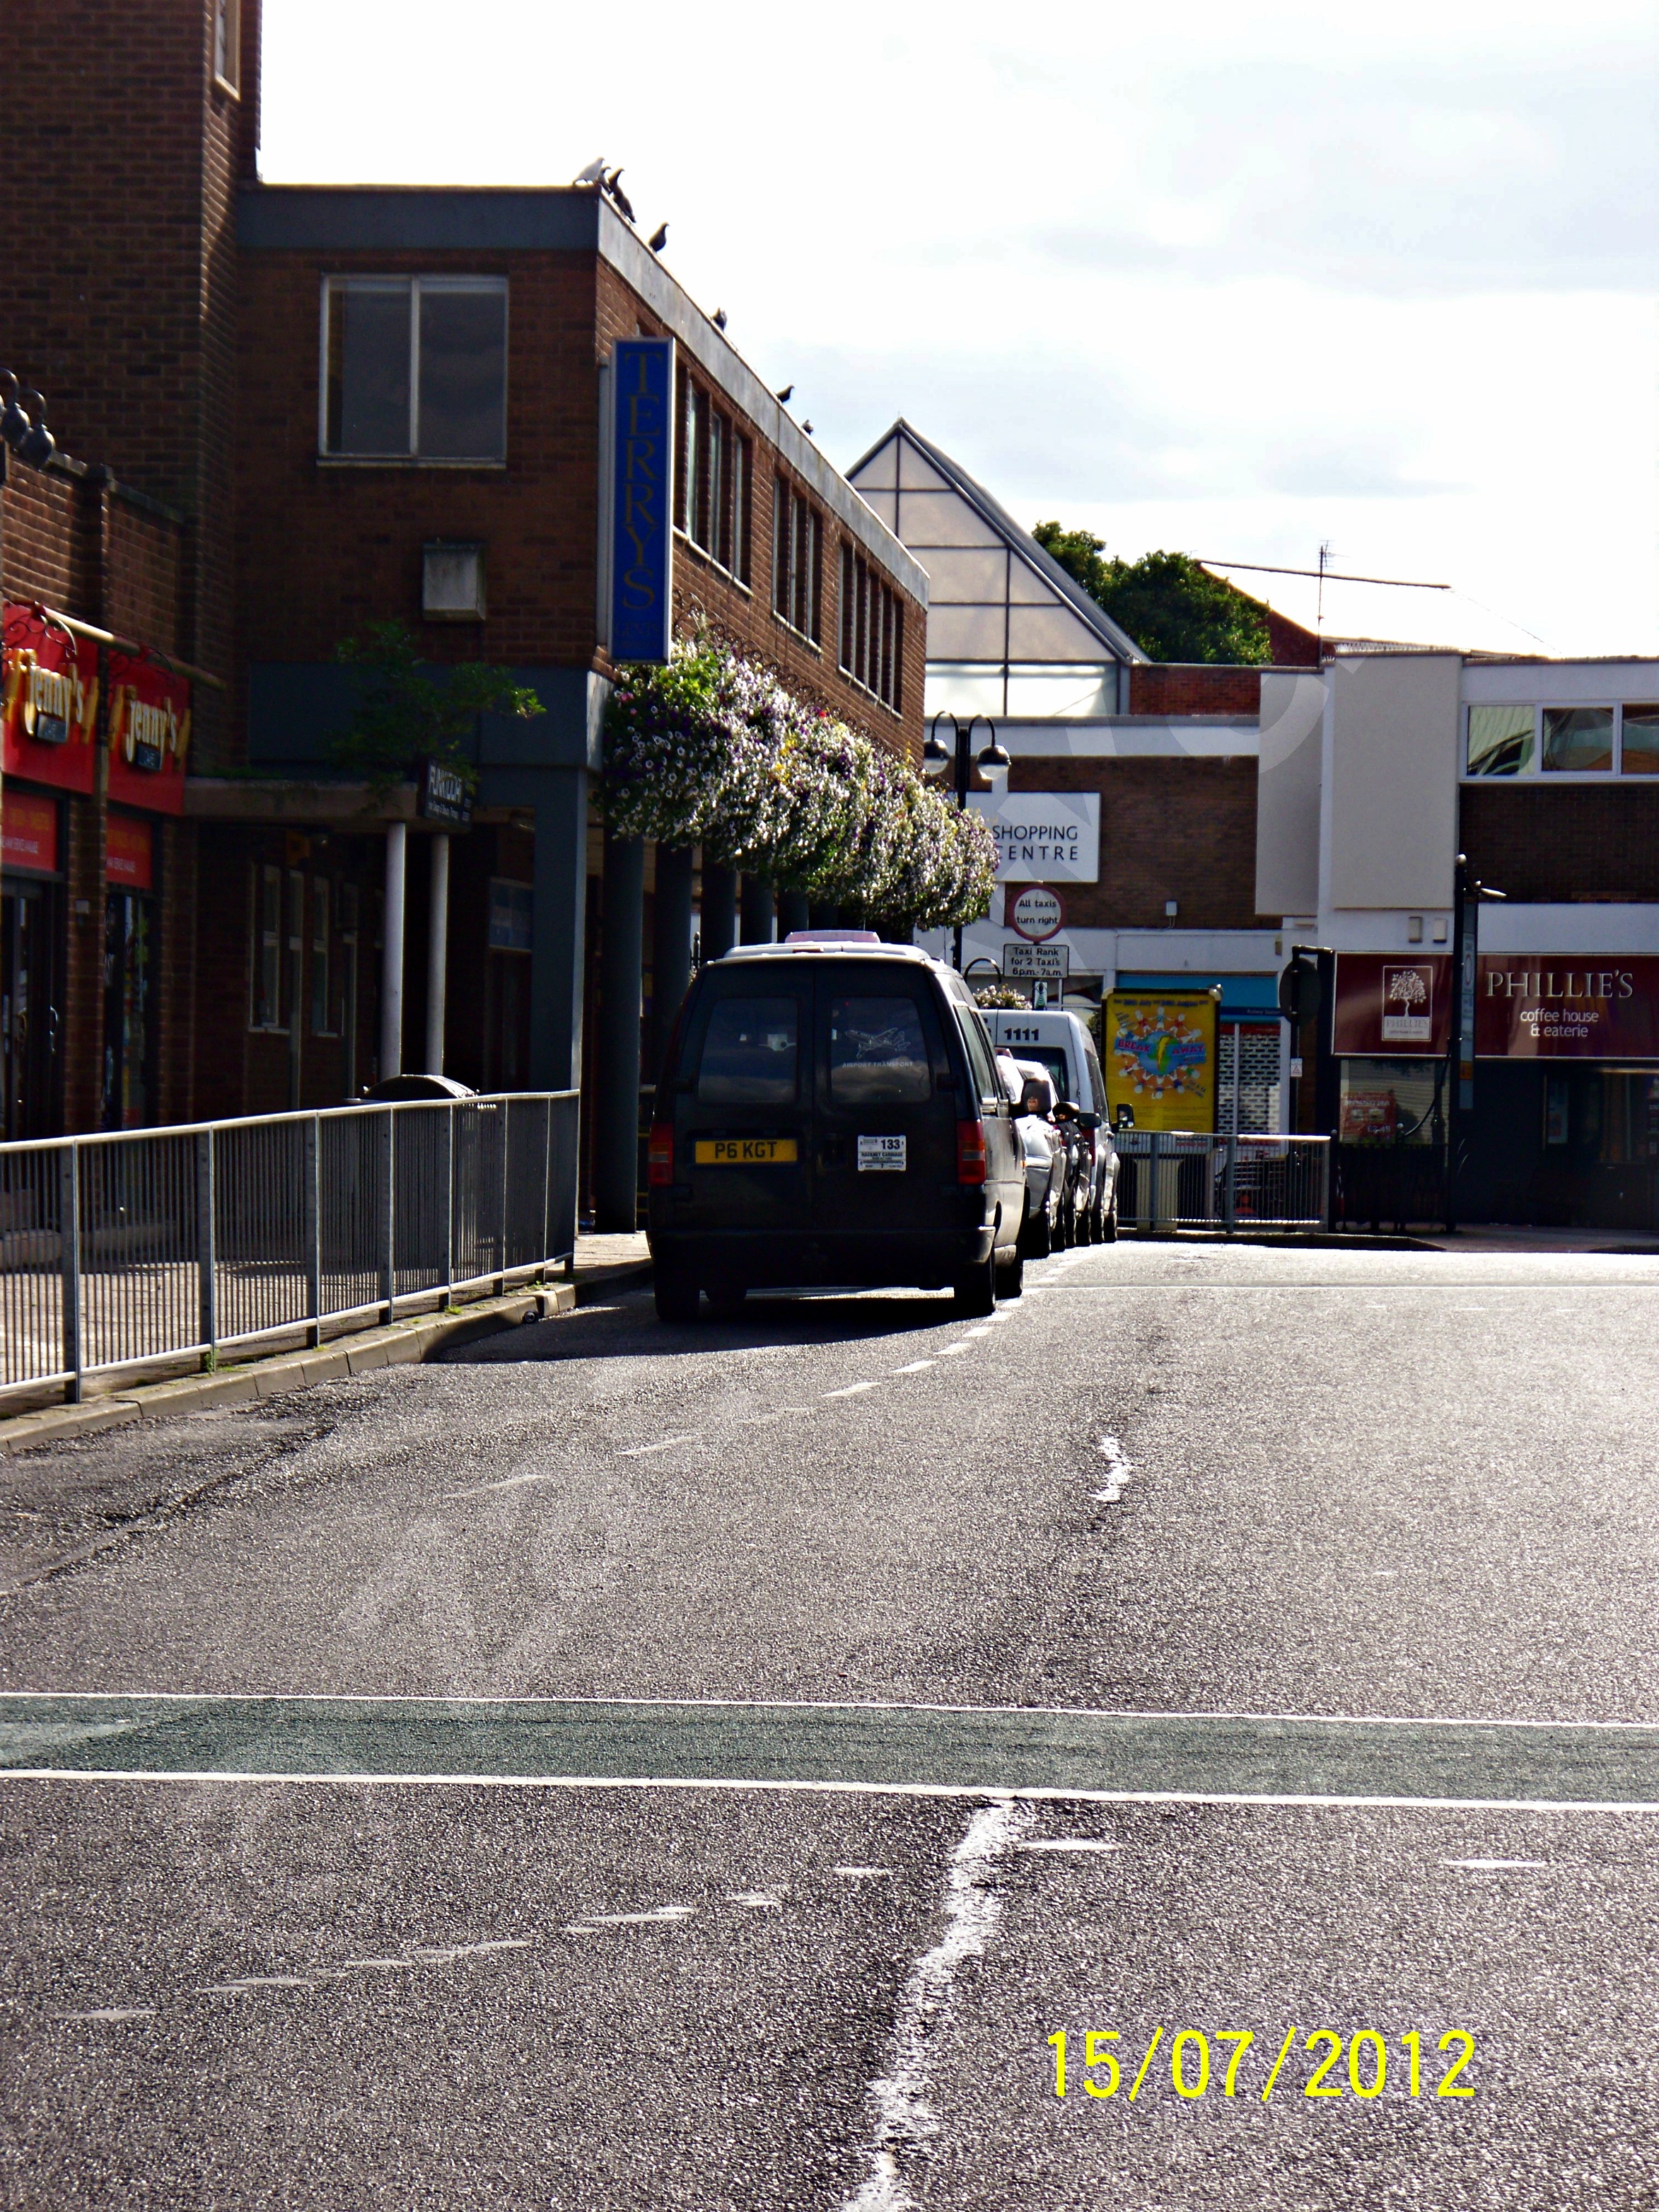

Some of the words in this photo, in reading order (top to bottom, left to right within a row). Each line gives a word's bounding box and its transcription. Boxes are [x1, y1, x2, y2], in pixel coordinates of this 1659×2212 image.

[623, 352, 663, 609] TERRYS
[992, 825, 1078, 840] SHOPPING
[1019, 900, 1031, 908] All
[1035, 900, 1056, 908] taxis
[1038, 916, 1059, 925] right
[1013, 946, 1032, 955] Taxi
[1037, 947, 1059, 956] Rank
[1485, 969, 1634, 999] PHILLIE'S
[1520, 1008, 1560, 1022] coffee
[1562, 1008, 1600, 1023] house
[1003, 1028, 1040, 1041] 1111
[1530, 1023, 1541, 1037] &
[1543, 1025, 1589, 1038] eaterie
[1117, 1038, 1151, 1053] BREAK
[1171, 1044, 1205, 1055] AWAY
[714, 1141, 738, 1159] P6
[743, 1141, 777, 1159] KGT
[880, 1139, 901, 1151] 133
